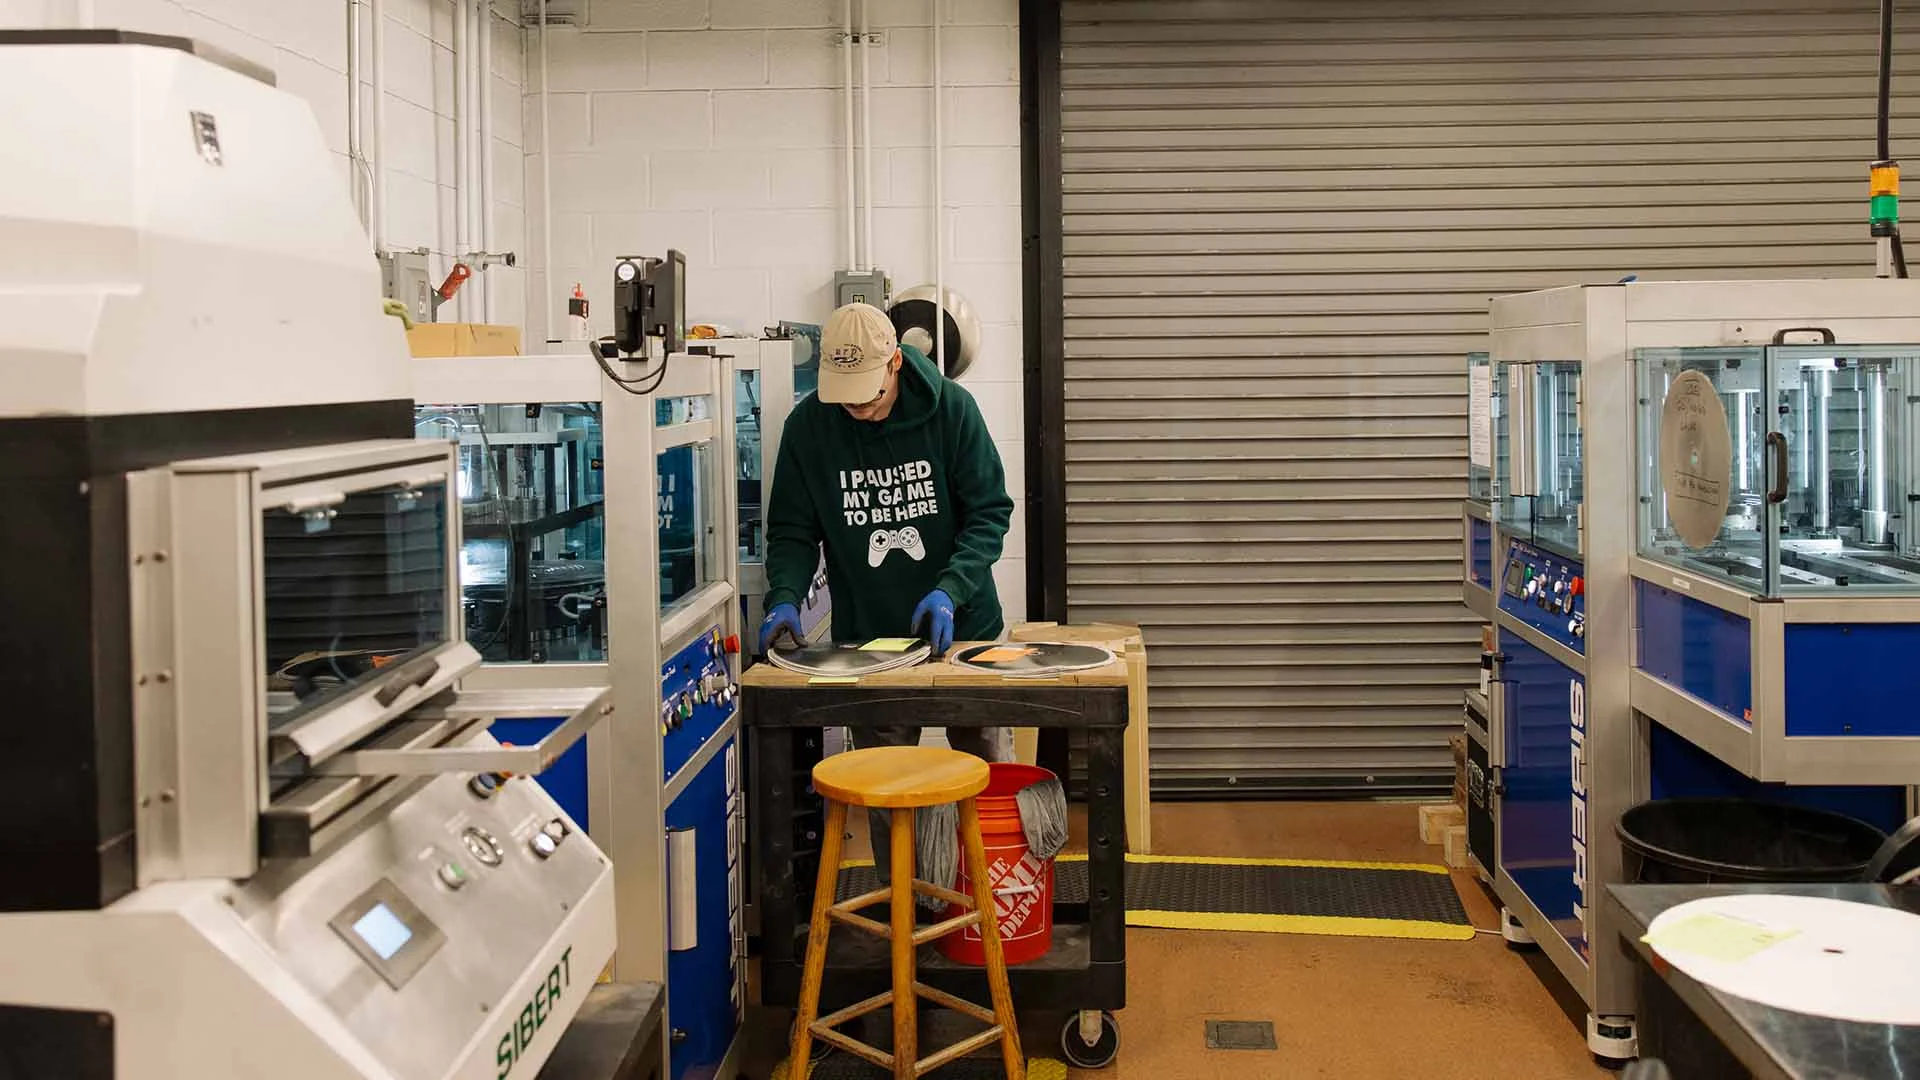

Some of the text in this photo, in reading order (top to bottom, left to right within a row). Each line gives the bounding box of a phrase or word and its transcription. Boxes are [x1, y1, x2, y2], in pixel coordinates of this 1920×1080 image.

[840, 460, 932, 489] I PAUSED
[843, 480, 936, 508] MY GAME
[843, 499, 938, 526] TO BE HERE
[986, 857, 1012, 887] HE
[496, 945, 572, 1080] SIBERT
